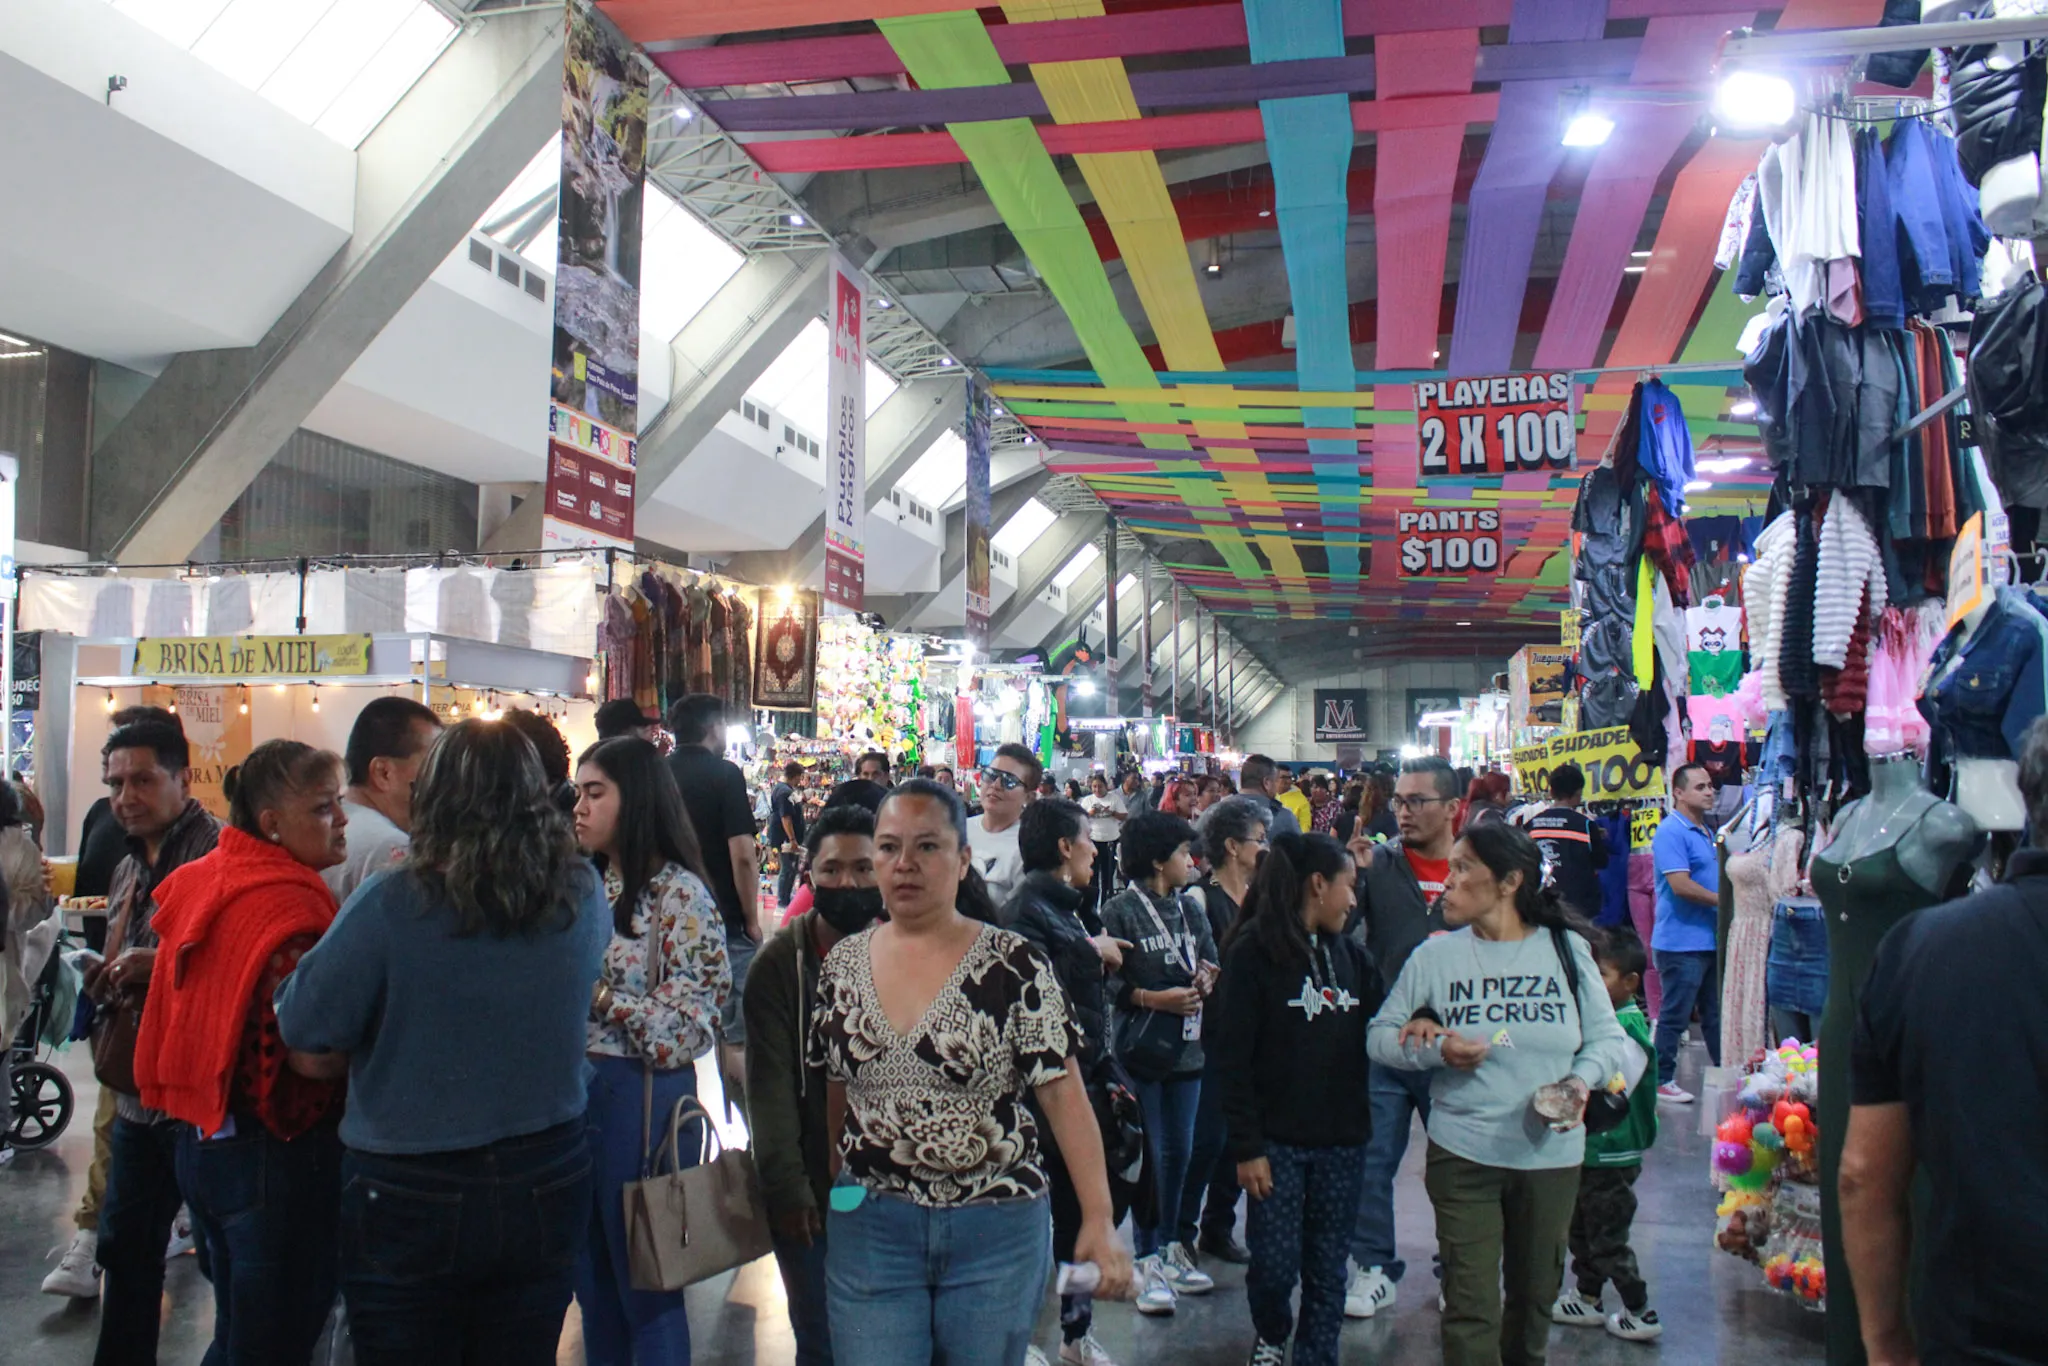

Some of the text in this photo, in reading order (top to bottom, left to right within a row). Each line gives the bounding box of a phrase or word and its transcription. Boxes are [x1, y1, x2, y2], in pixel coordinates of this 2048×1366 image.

[1418, 373, 1568, 409] PLAYERAS
[1420, 410, 1571, 475] 2 X 100
[838, 395, 847, 523] Pueblos
[1399, 509, 1499, 533] PANTS
[1401, 536, 1499, 576] $100
[157, 641, 224, 675] BRISA
[231, 648, 255, 674] DE
[261, 640, 323, 674] MIEL
[178, 688, 209, 706] BRISA
[196, 706, 221, 723] MIEL
[1521, 767, 1549, 794] $10
[1568, 754, 1655, 795] 100
[1449, 976, 1561, 1002] IN PIZZA
[1445, 1002, 1567, 1028] WE CRUST
